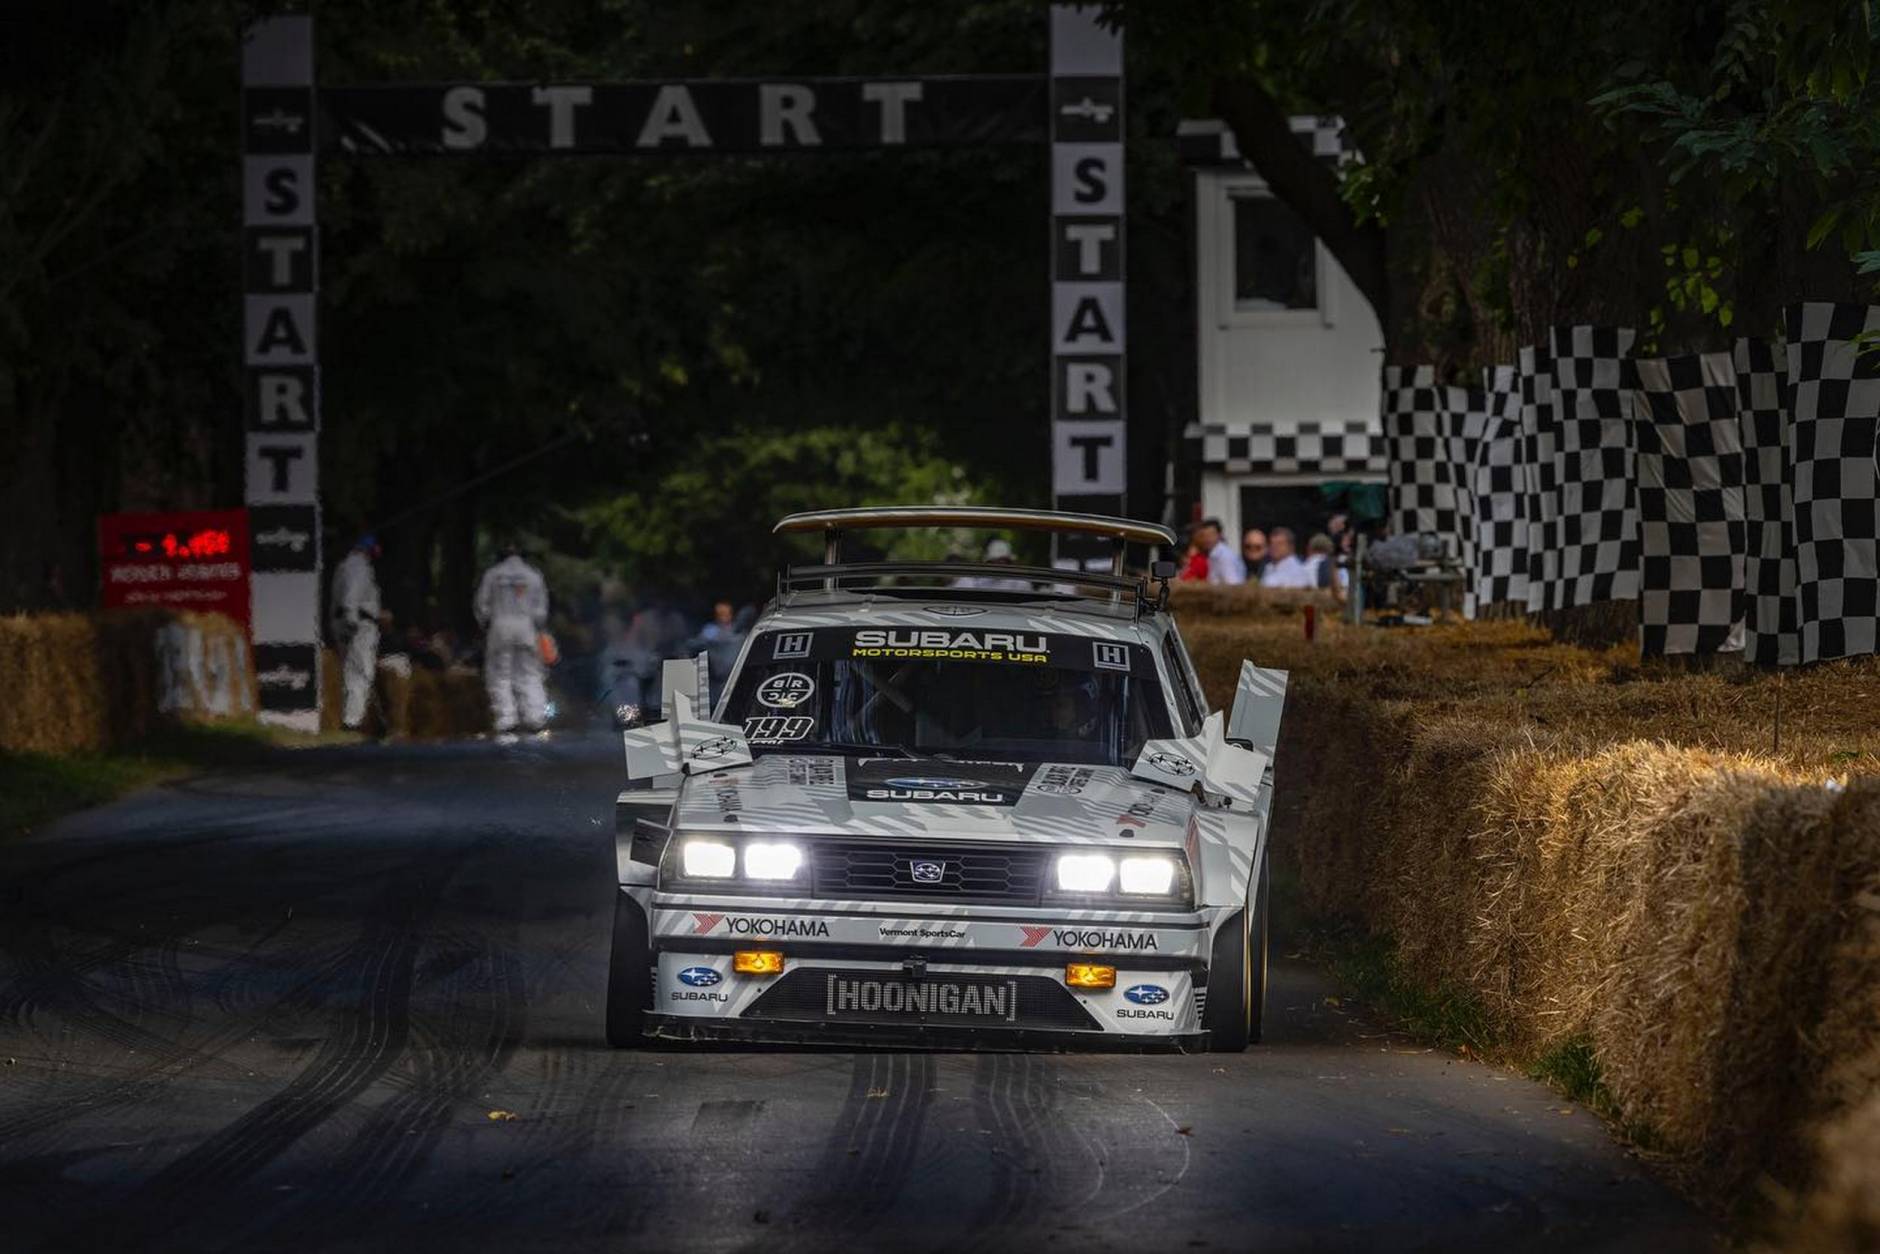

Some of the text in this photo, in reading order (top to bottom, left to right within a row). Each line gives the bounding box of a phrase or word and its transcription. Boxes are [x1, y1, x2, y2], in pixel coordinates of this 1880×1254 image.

[442, 84, 923, 148] START
[255, 167, 308, 493] START
[1064, 157, 1118, 483] START
[855, 630, 1047, 652] SUBARU
[853, 649, 1047, 663] MOTORSPORTS USA
[744, 717, 814, 739] 199
[866, 789, 1003, 803] SUBARU
[725, 917, 830, 937] YOKOHAMA
[879, 927, 919, 937] Vermont
[1053, 930, 1158, 950] YOKOHAMA
[671, 991, 729, 1002] SUBARU
[1116, 1009, 1175, 1021] SUBARU
